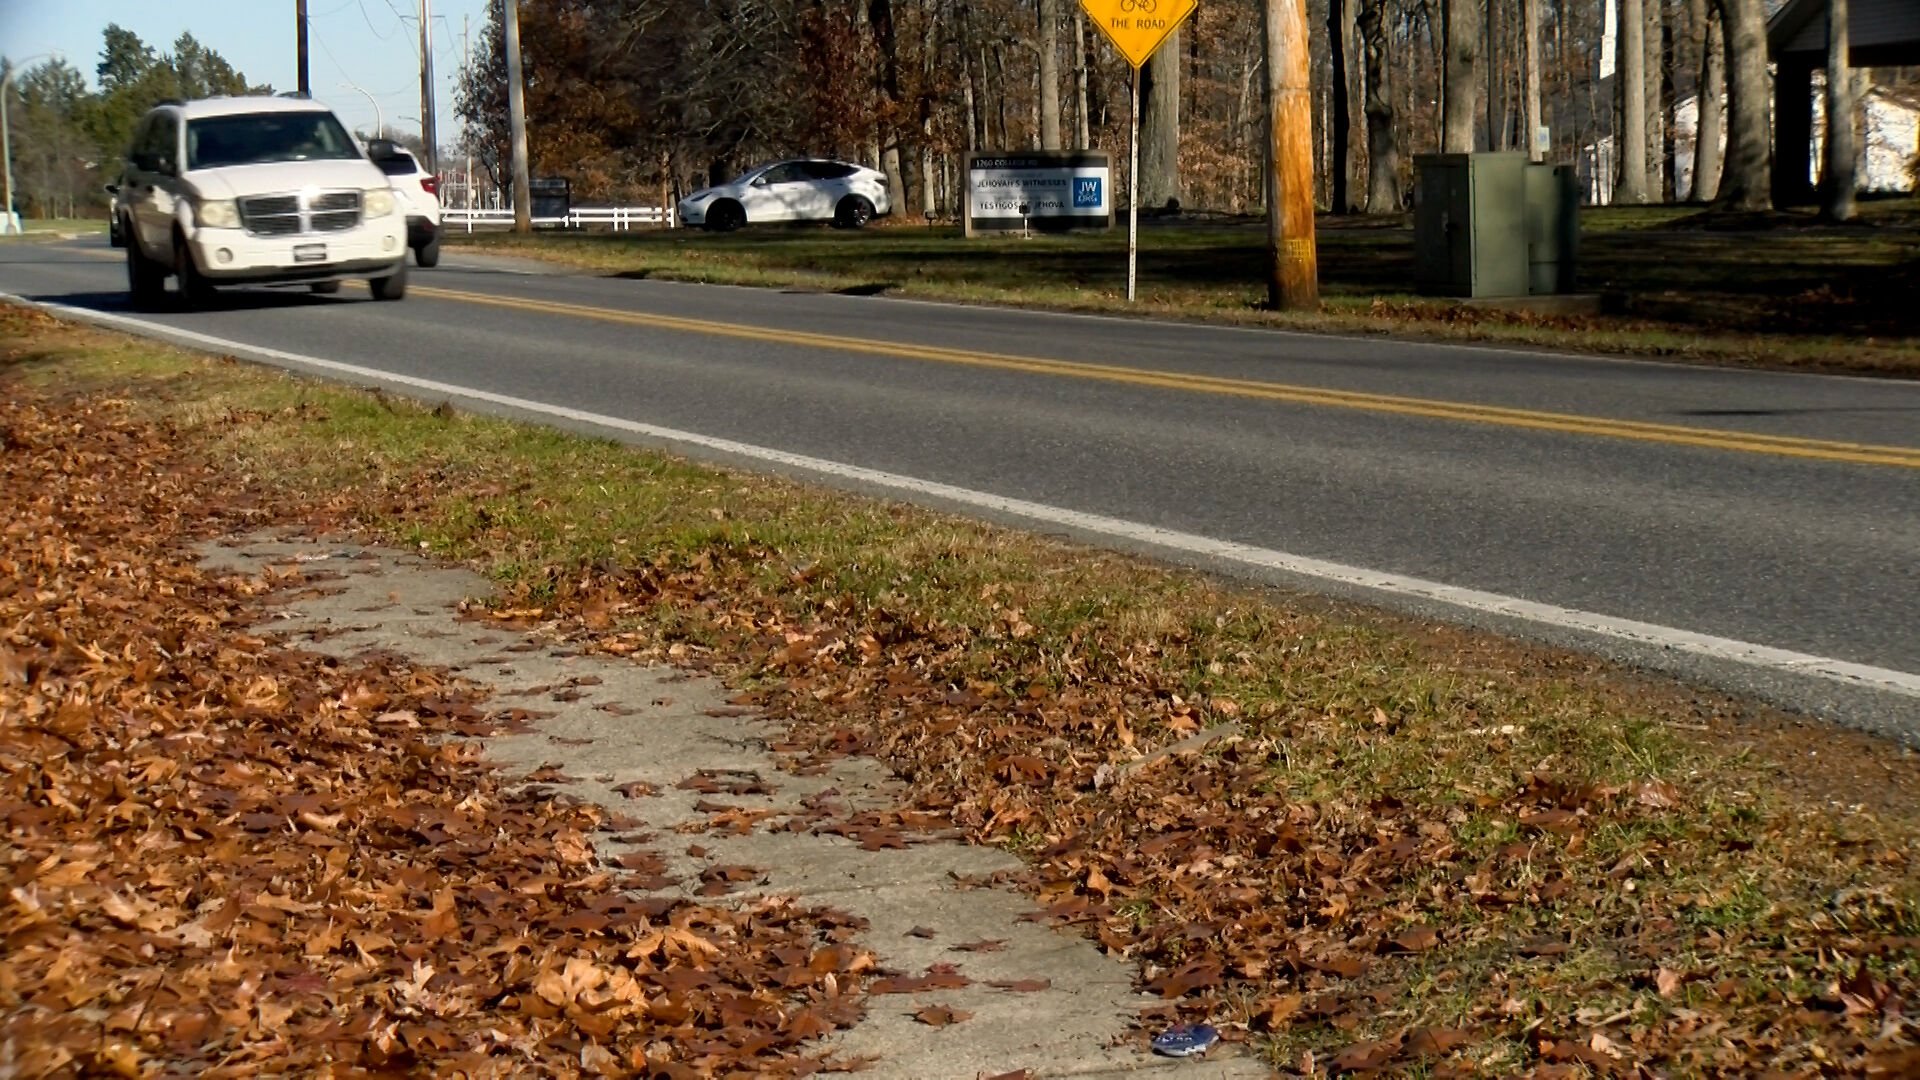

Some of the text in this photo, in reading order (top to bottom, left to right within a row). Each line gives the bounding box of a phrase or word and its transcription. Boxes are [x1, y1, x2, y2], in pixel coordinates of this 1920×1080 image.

[1111, 18, 1166, 29] THE ROAD
[1081, 181, 1098, 192] JW
[980, 201, 1018, 210] TESTIGOS
